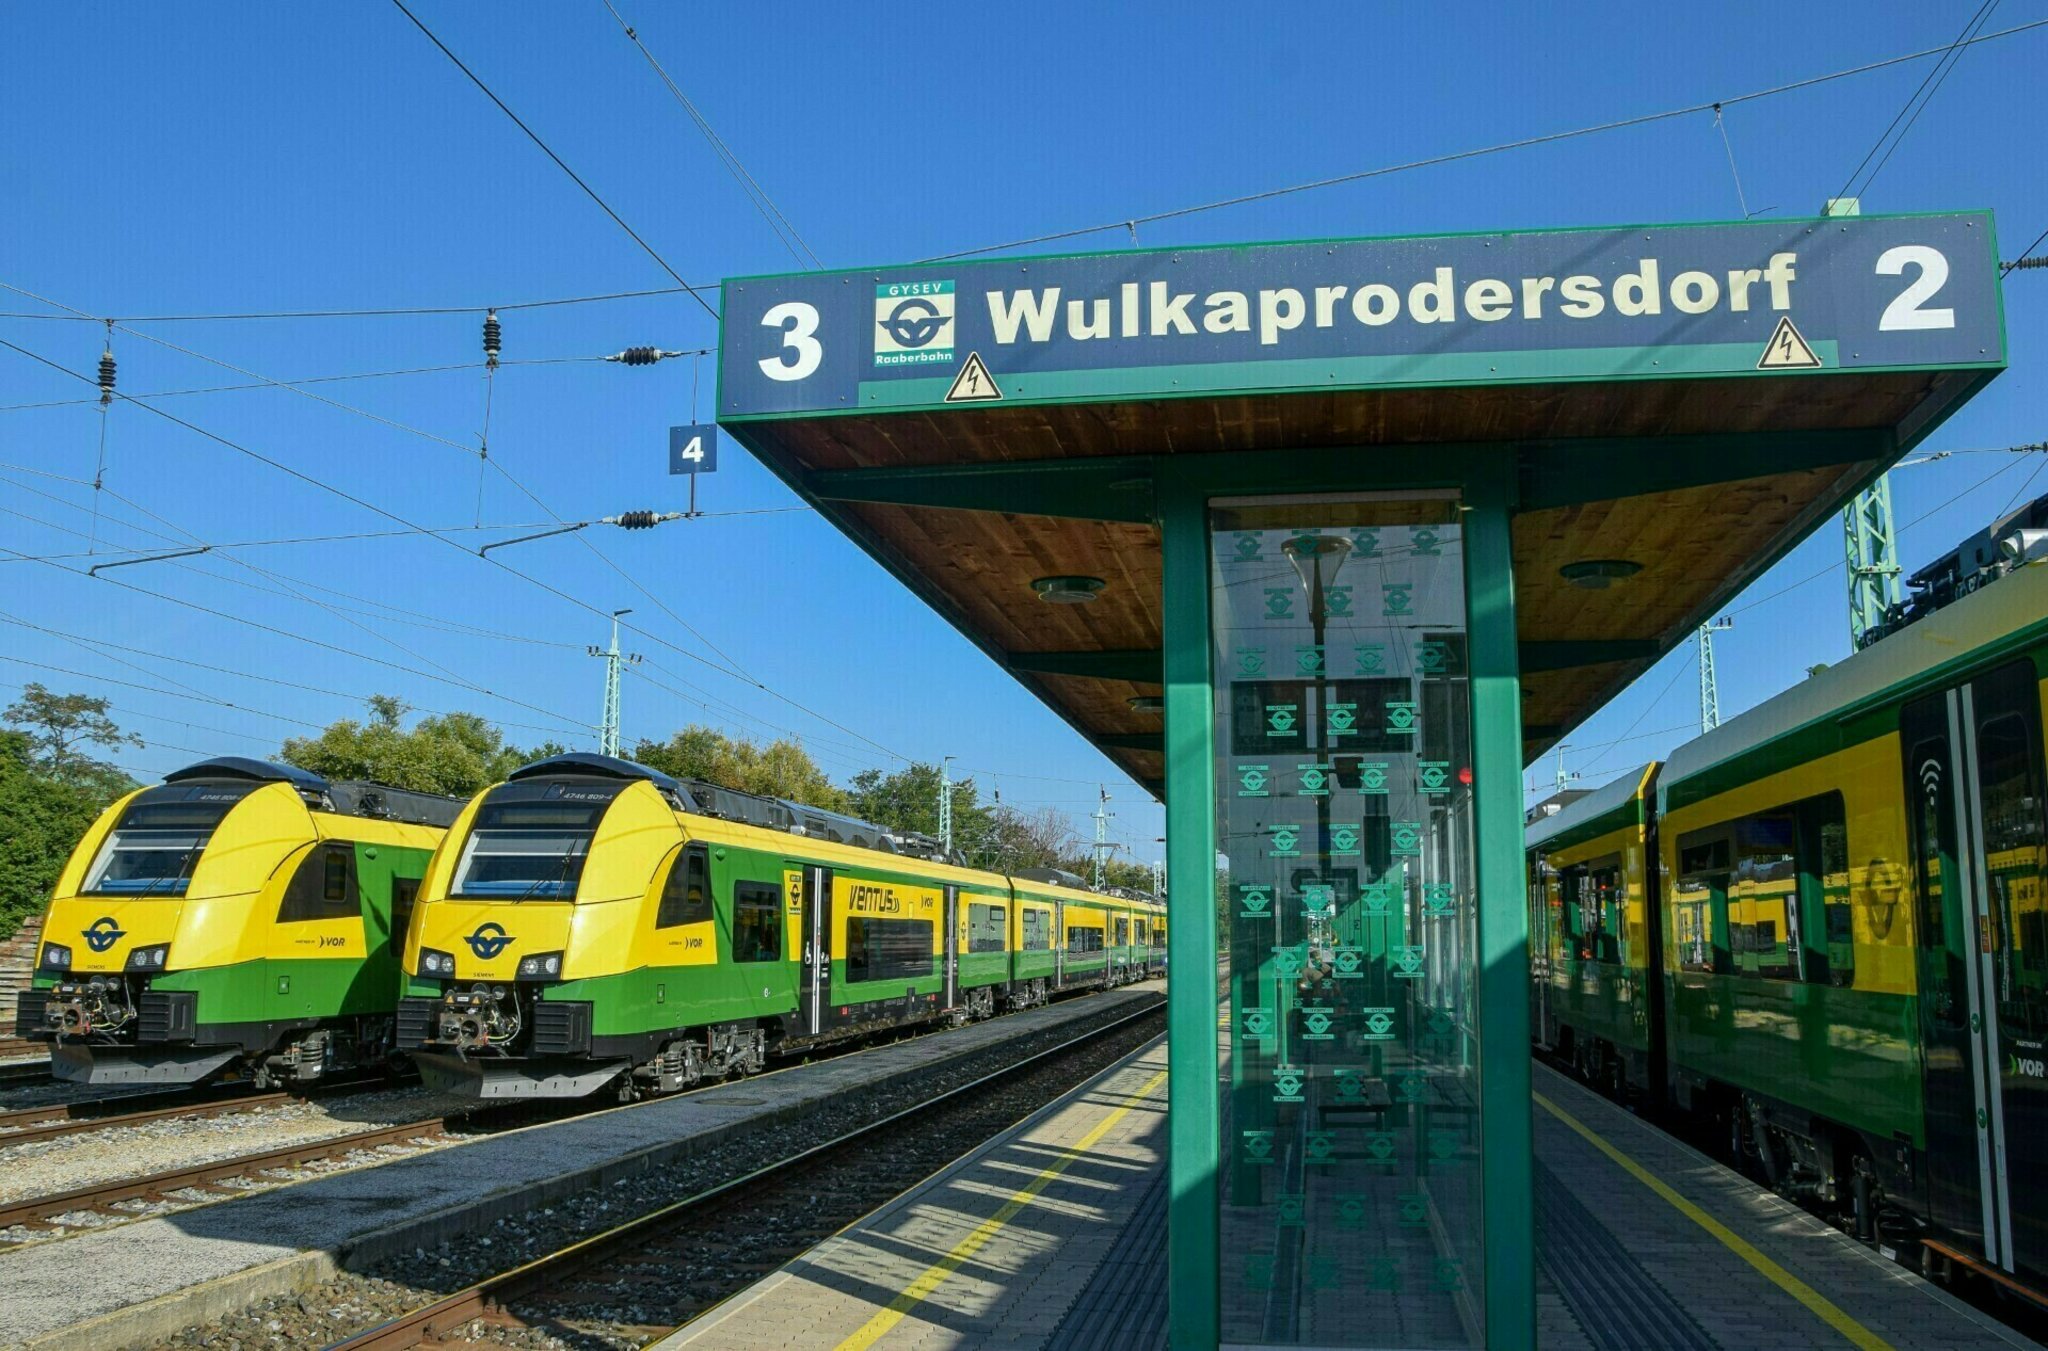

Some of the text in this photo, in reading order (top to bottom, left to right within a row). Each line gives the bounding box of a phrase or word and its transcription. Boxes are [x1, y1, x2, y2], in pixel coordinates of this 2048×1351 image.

[889, 283, 941, 296] GYSEV
[1875, 245, 1955, 331] 2
[986, 252, 1798, 346] Wulkaprodersdorf
[758, 302, 823, 382] 3
[876, 351, 953, 364] Raaberbahn
[681, 436, 705, 463] 4
[326, 937, 346, 947] VOR
[689, 938, 703, 948] VOR
[2017, 1057, 2044, 1078] VOR
